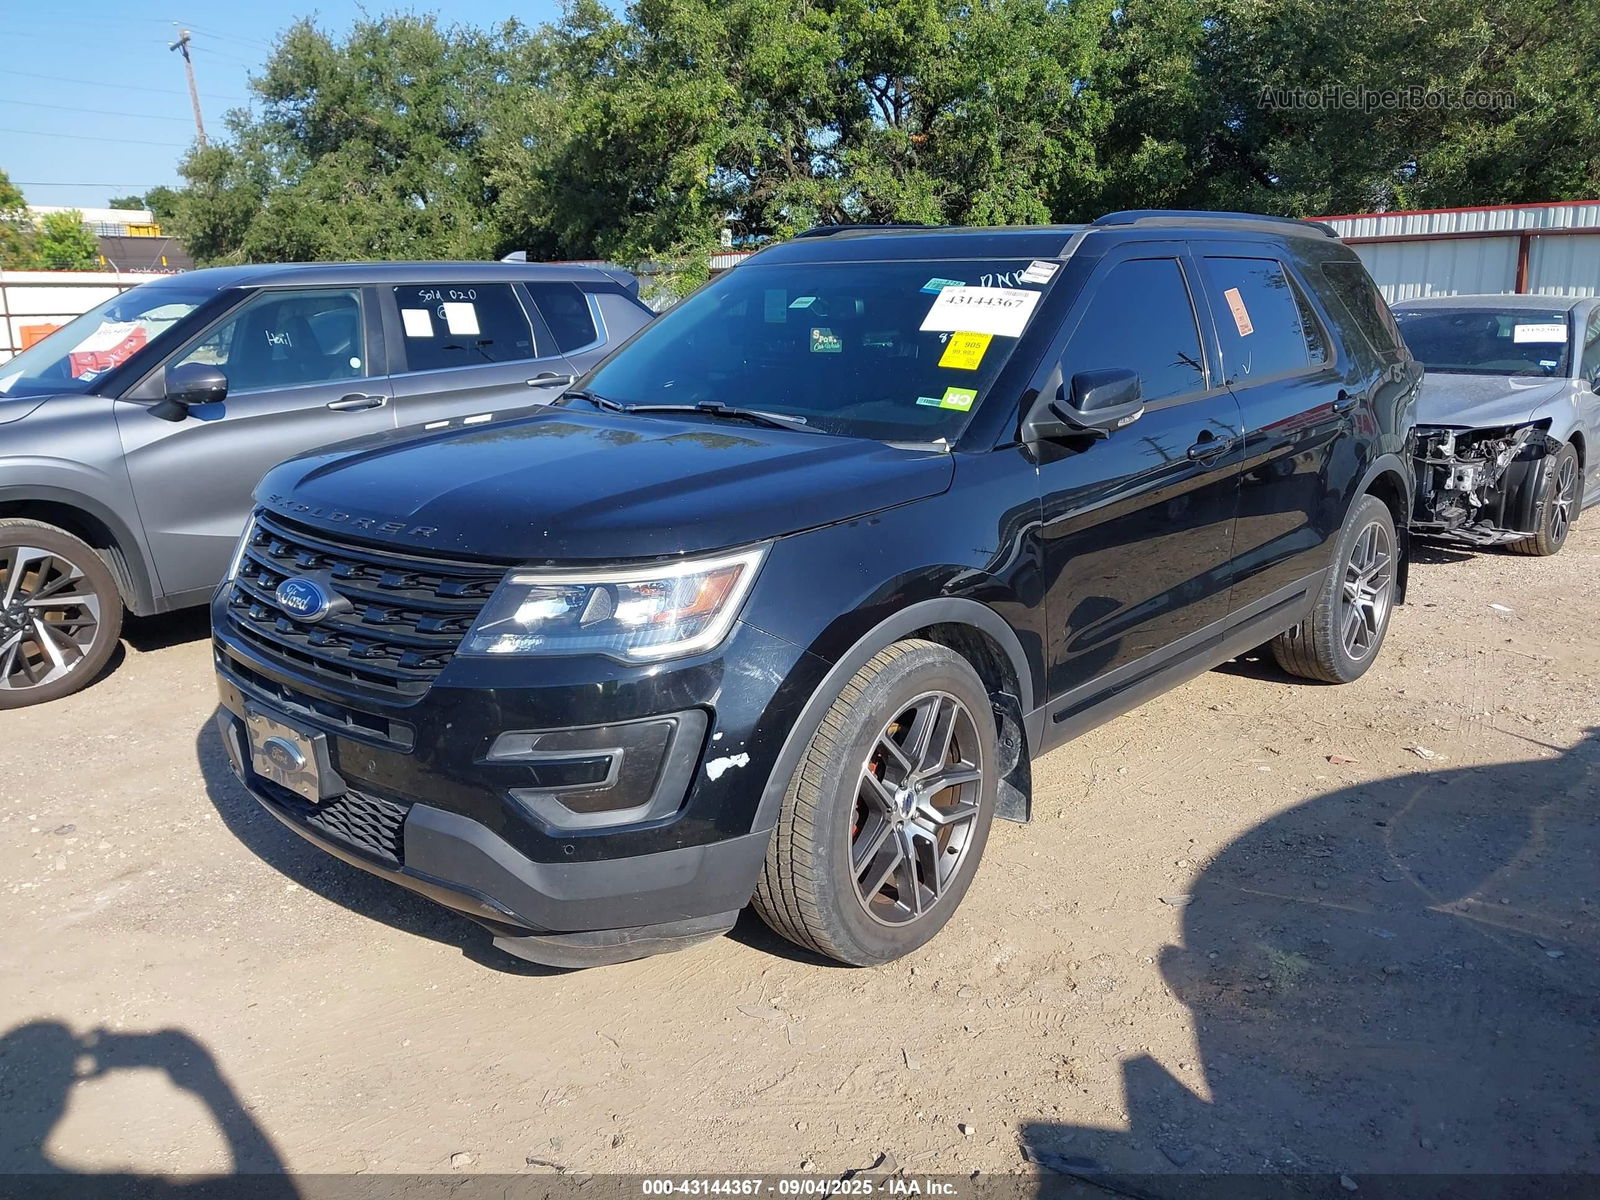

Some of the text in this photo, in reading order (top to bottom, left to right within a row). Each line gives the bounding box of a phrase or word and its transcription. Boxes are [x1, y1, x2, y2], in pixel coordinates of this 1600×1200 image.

[418, 289, 444, 302] Sold
[946, 295, 1024, 308] 43144367
[964, 341, 981, 349] 905
[269, 494, 438, 537] EXPLORER
[277, 583, 311, 611] Ford
